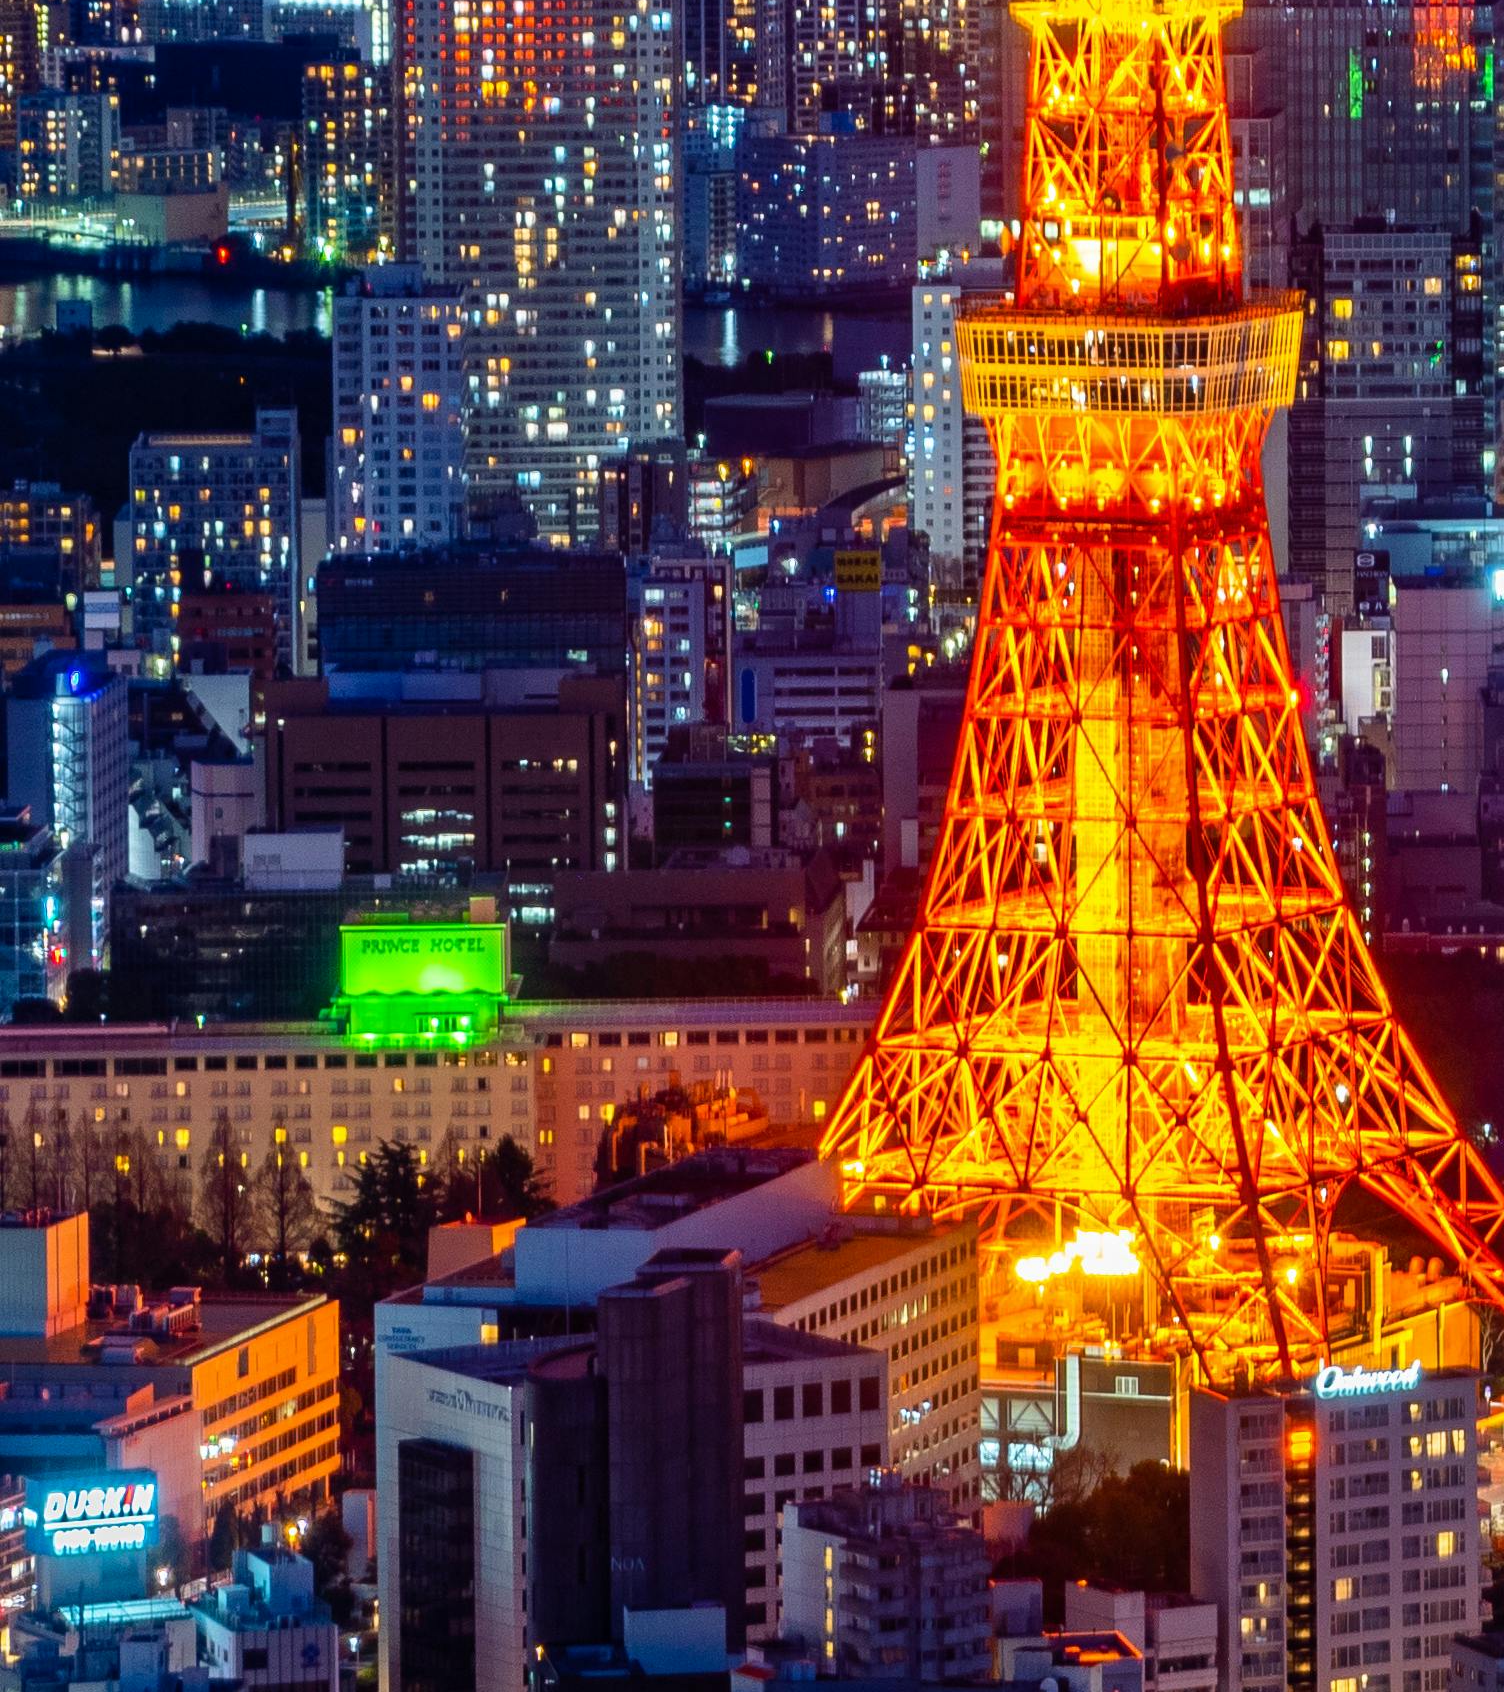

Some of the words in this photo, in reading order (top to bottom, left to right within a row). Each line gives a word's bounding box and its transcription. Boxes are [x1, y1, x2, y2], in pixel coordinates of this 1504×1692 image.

[361, 937, 420, 954] PRINCE
[430, 937, 485, 953] HOTEL
[1316, 1358, 1421, 1399] Oakwood
[611, 1557, 645, 1572] NOA
